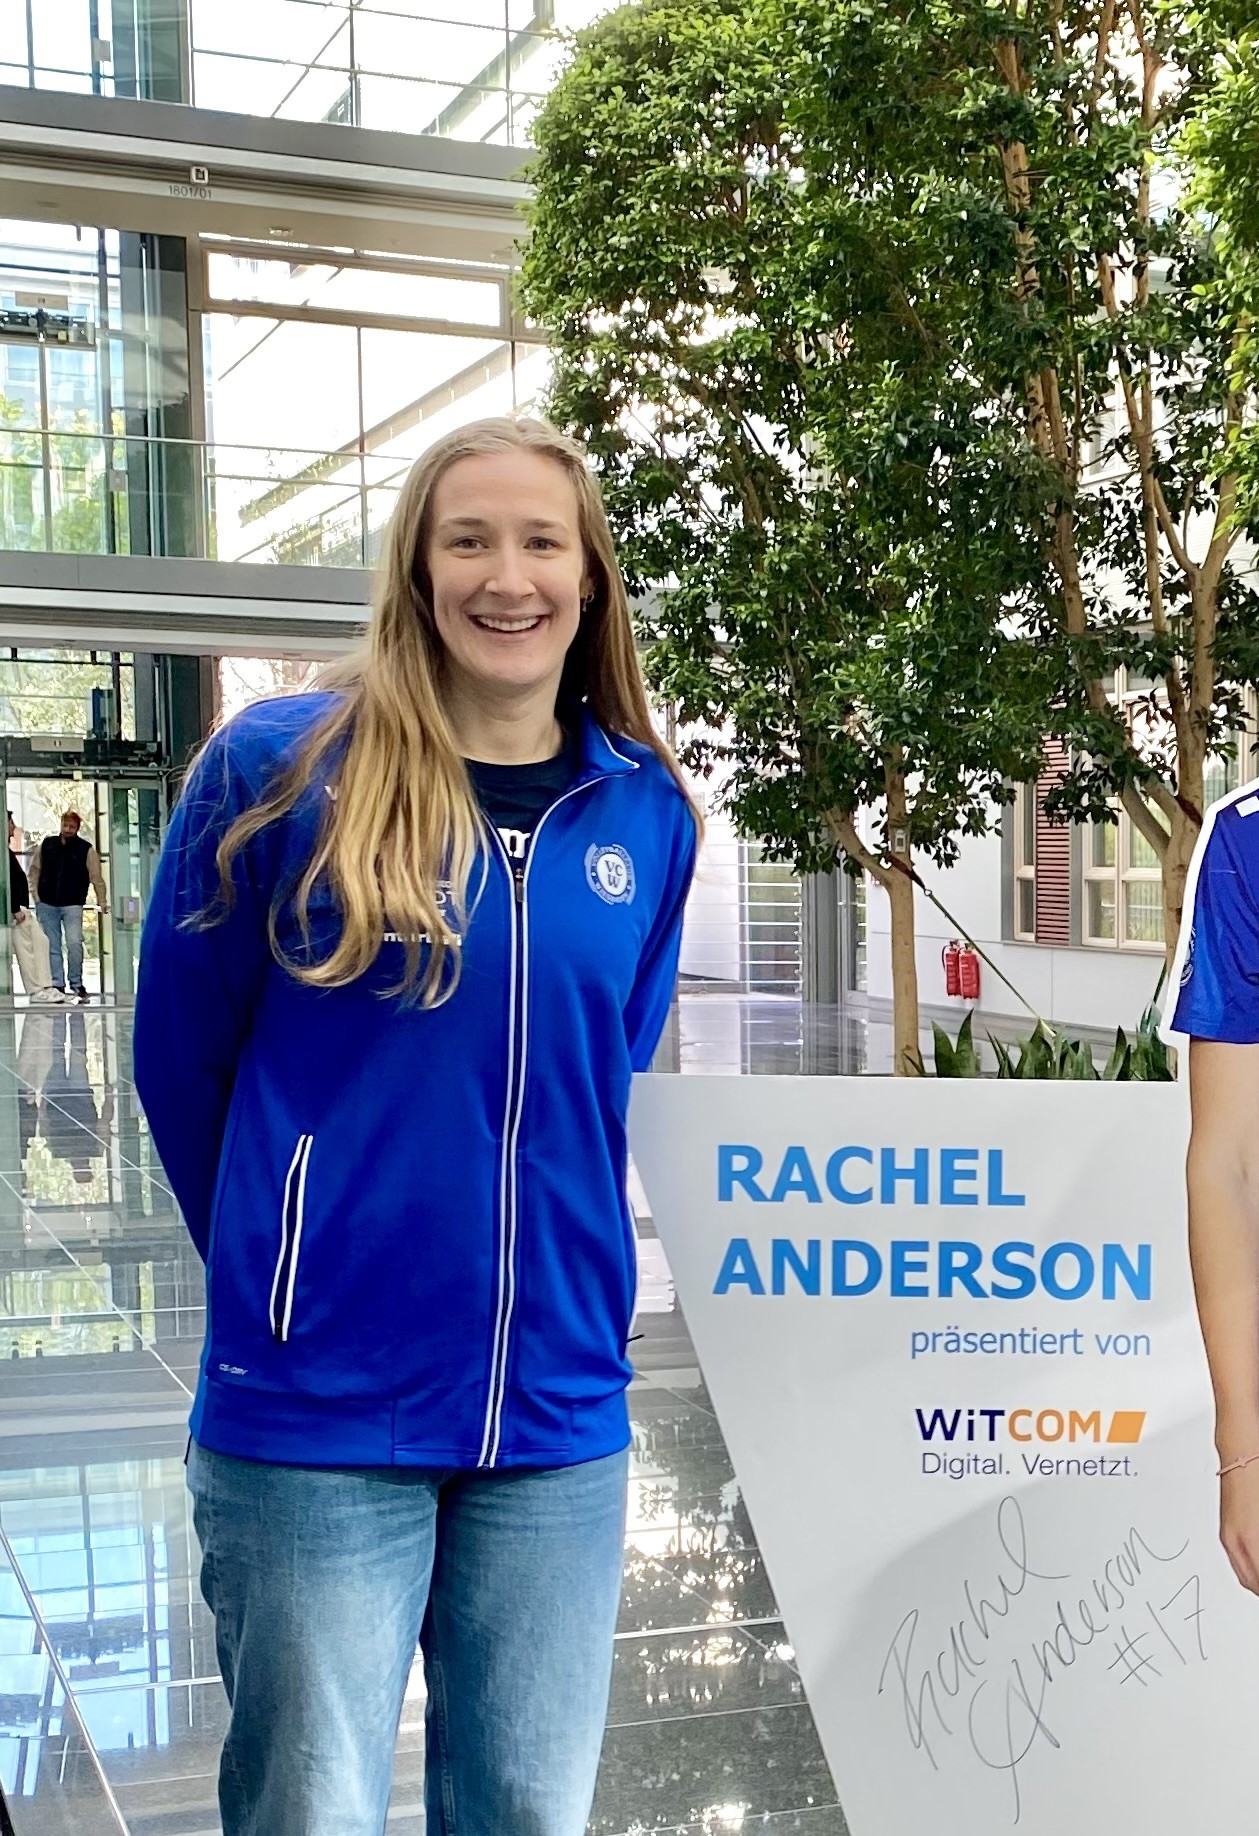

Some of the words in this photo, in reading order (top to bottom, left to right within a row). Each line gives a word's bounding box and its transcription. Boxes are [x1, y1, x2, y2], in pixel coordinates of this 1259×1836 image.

[168, 184, 212, 199] 1801/01
[716, 1144, 1027, 1207] RACHEL
[712, 1238, 1153, 1302] ANDERSON
[910, 1326, 1083, 1360] präsentiert
[1095, 1334, 1151, 1356] von
[922, 1452, 1010, 1480] Digital.
[1021, 1453, 1139, 1477] Vernetzt.
[1107, 1574, 1209, 1687] #17
